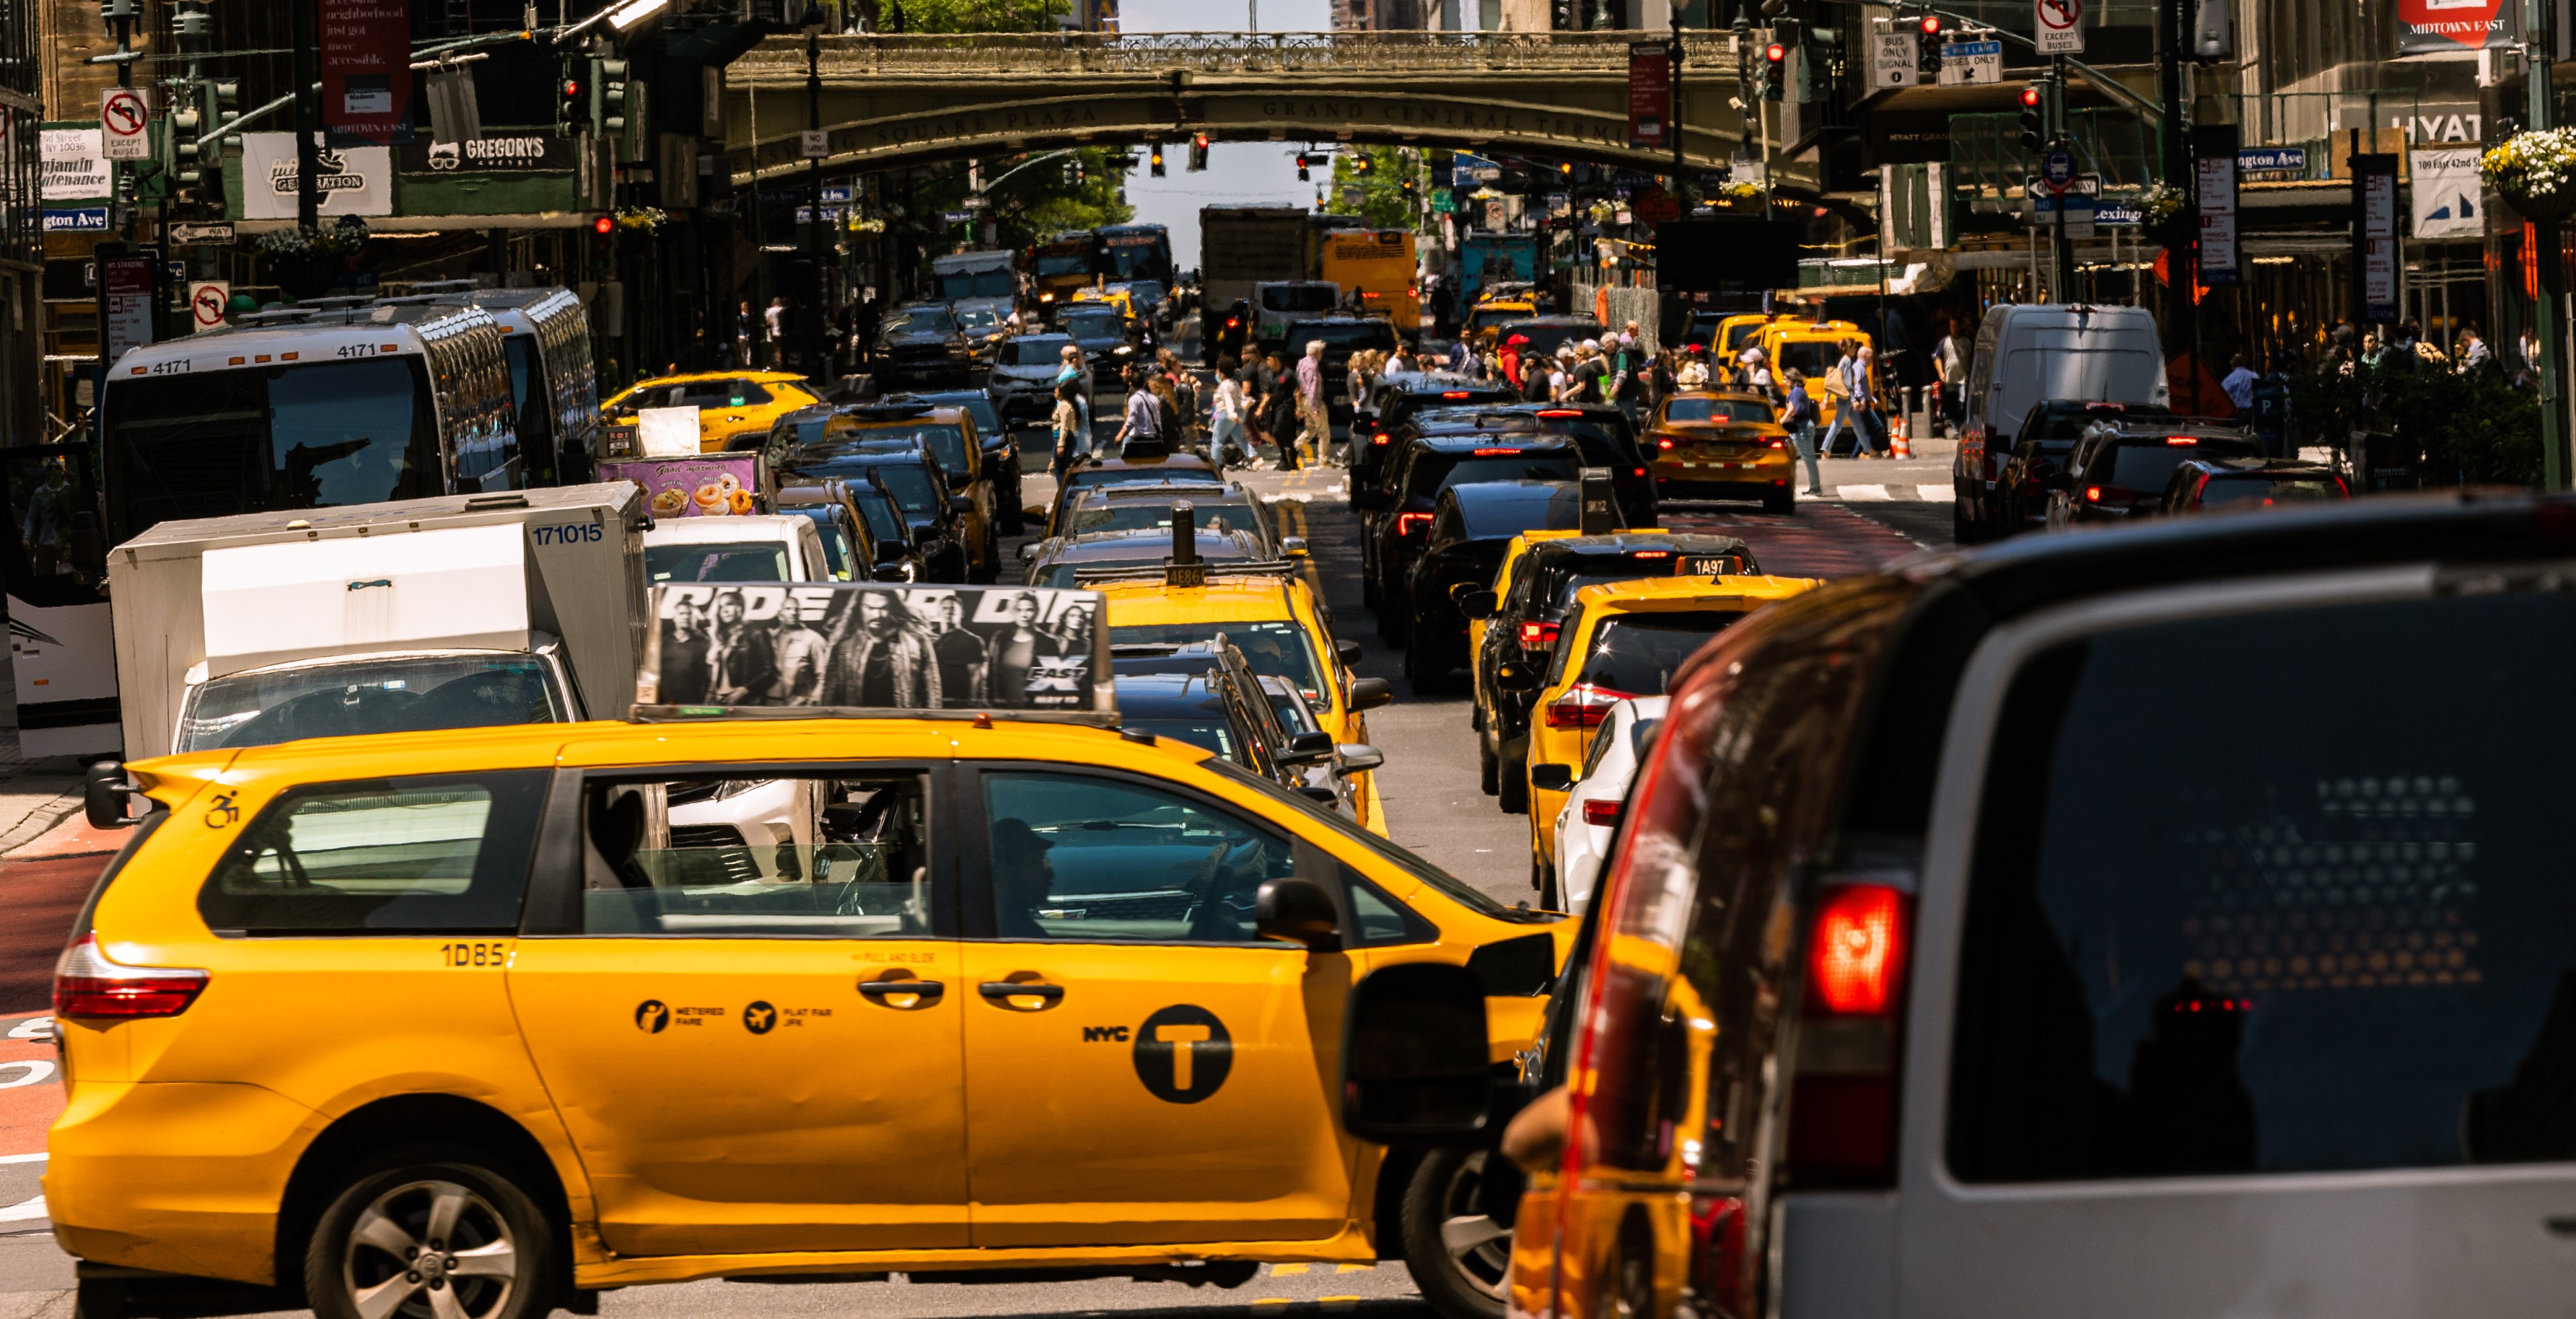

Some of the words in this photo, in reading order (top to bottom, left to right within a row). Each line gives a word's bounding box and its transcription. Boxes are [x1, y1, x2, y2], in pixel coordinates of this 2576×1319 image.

[326, 7, 404, 20] neighborhood
[348, 25, 366, 36] got
[2410, 21, 2471, 34] MIDTOWN
[2475, 19, 2506, 32] EAST
[1886, 37, 1904, 46] BUS
[2045, 32, 2075, 40] EXCEPT
[327, 43, 356, 51] more
[1953, 45, 1969, 53] BUS
[1972, 44, 1994, 52] LANE
[2047, 41, 2074, 50] BUSES
[1883, 47, 1909, 57] ONLY
[328, 53, 386, 66] accessible.
[1878, 59, 1913, 69] SIGNAL
[1941, 56, 1970, 67] BUSES
[1974, 56, 1996, 65] ONLY
[1263, 102, 1362, 119] GRAND
[1384, 104, 1515, 129] CENTRAL
[331, 123, 382, 134] MIDTOWN
[877, 116, 986, 143] SQUARE
[1008, 105, 1097, 125] PLAZA
[111, 138, 141, 147] EXCEPT
[1889, 134, 1920, 142] HYATT
[46, 144, 57, 153] NY
[60, 142, 86, 152] 10036
[466, 136, 545, 159] GREGORYS
[2277, 151, 2302, 166] Ave
[2418, 161, 2432, 170] 109
[2433, 159, 2449, 168] East
[2451, 158, 2471, 167] 42nd
[276, 176, 360, 191] GERATION
[76, 213, 103, 226] Ave
[178, 229, 198, 238] ONE
[208, 227, 229, 235] WAY
[153, 359, 191, 374] 4171
[337, 343, 376, 358] 4171
[655, 464, 682, 478] Good
[686, 463, 727, 472] morning
[660, 479, 684, 488] MUFFIN
[533, 523, 602, 545] 171015
[1695, 560, 1724, 575] 1A97
[1170, 568, 1200, 584] 4E86
[1026, 666, 1088, 681] FAST
[440, 943, 504, 968] 1D85
[676, 1007, 724, 1016] METERED
[1083, 1026, 1130, 1042] NYC
[1154, 1024, 1212, 1092] T
